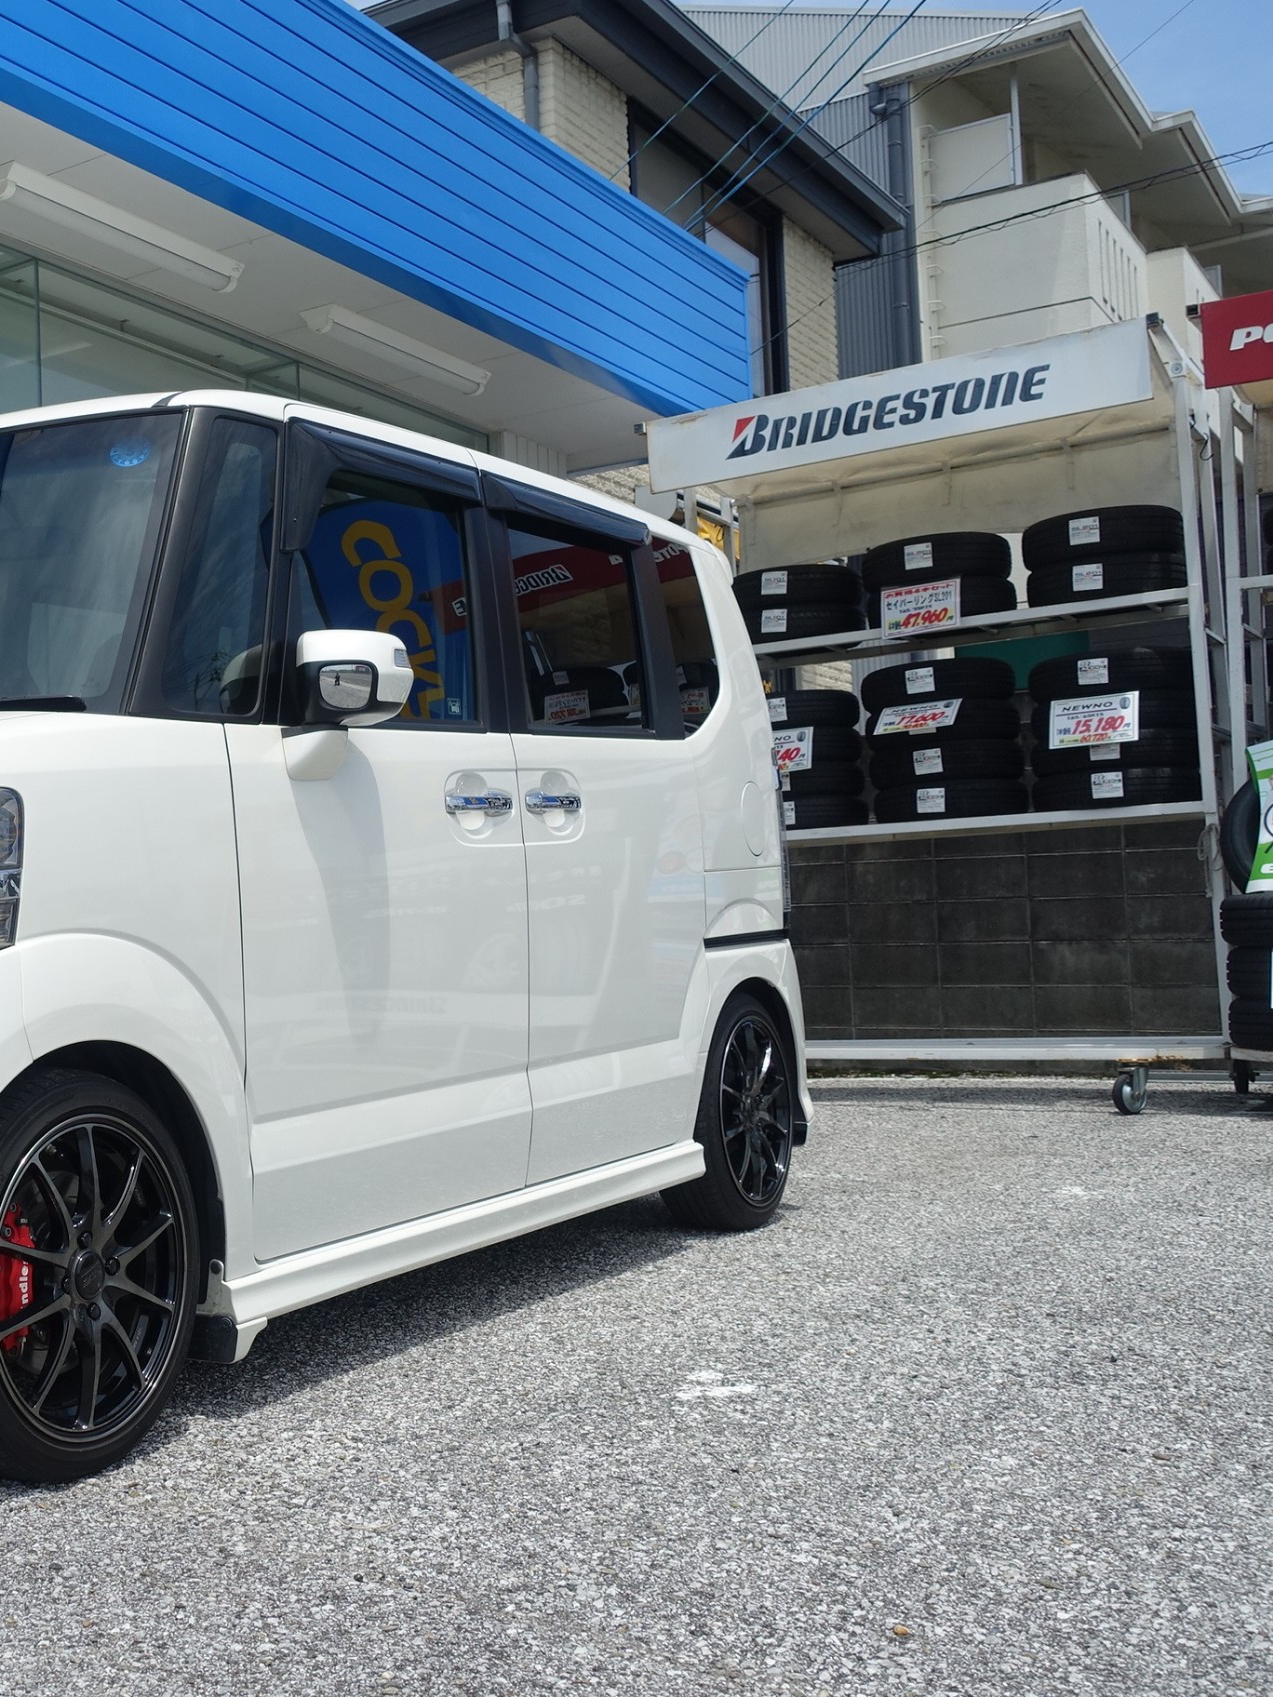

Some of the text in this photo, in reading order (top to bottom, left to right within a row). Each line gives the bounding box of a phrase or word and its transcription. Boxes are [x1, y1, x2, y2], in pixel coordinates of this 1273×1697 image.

[725, 364, 1050, 460] BRIDGESTONE
[892, 704, 938, 713] NEWNO
[1062, 701, 1113, 712] NEWNO
